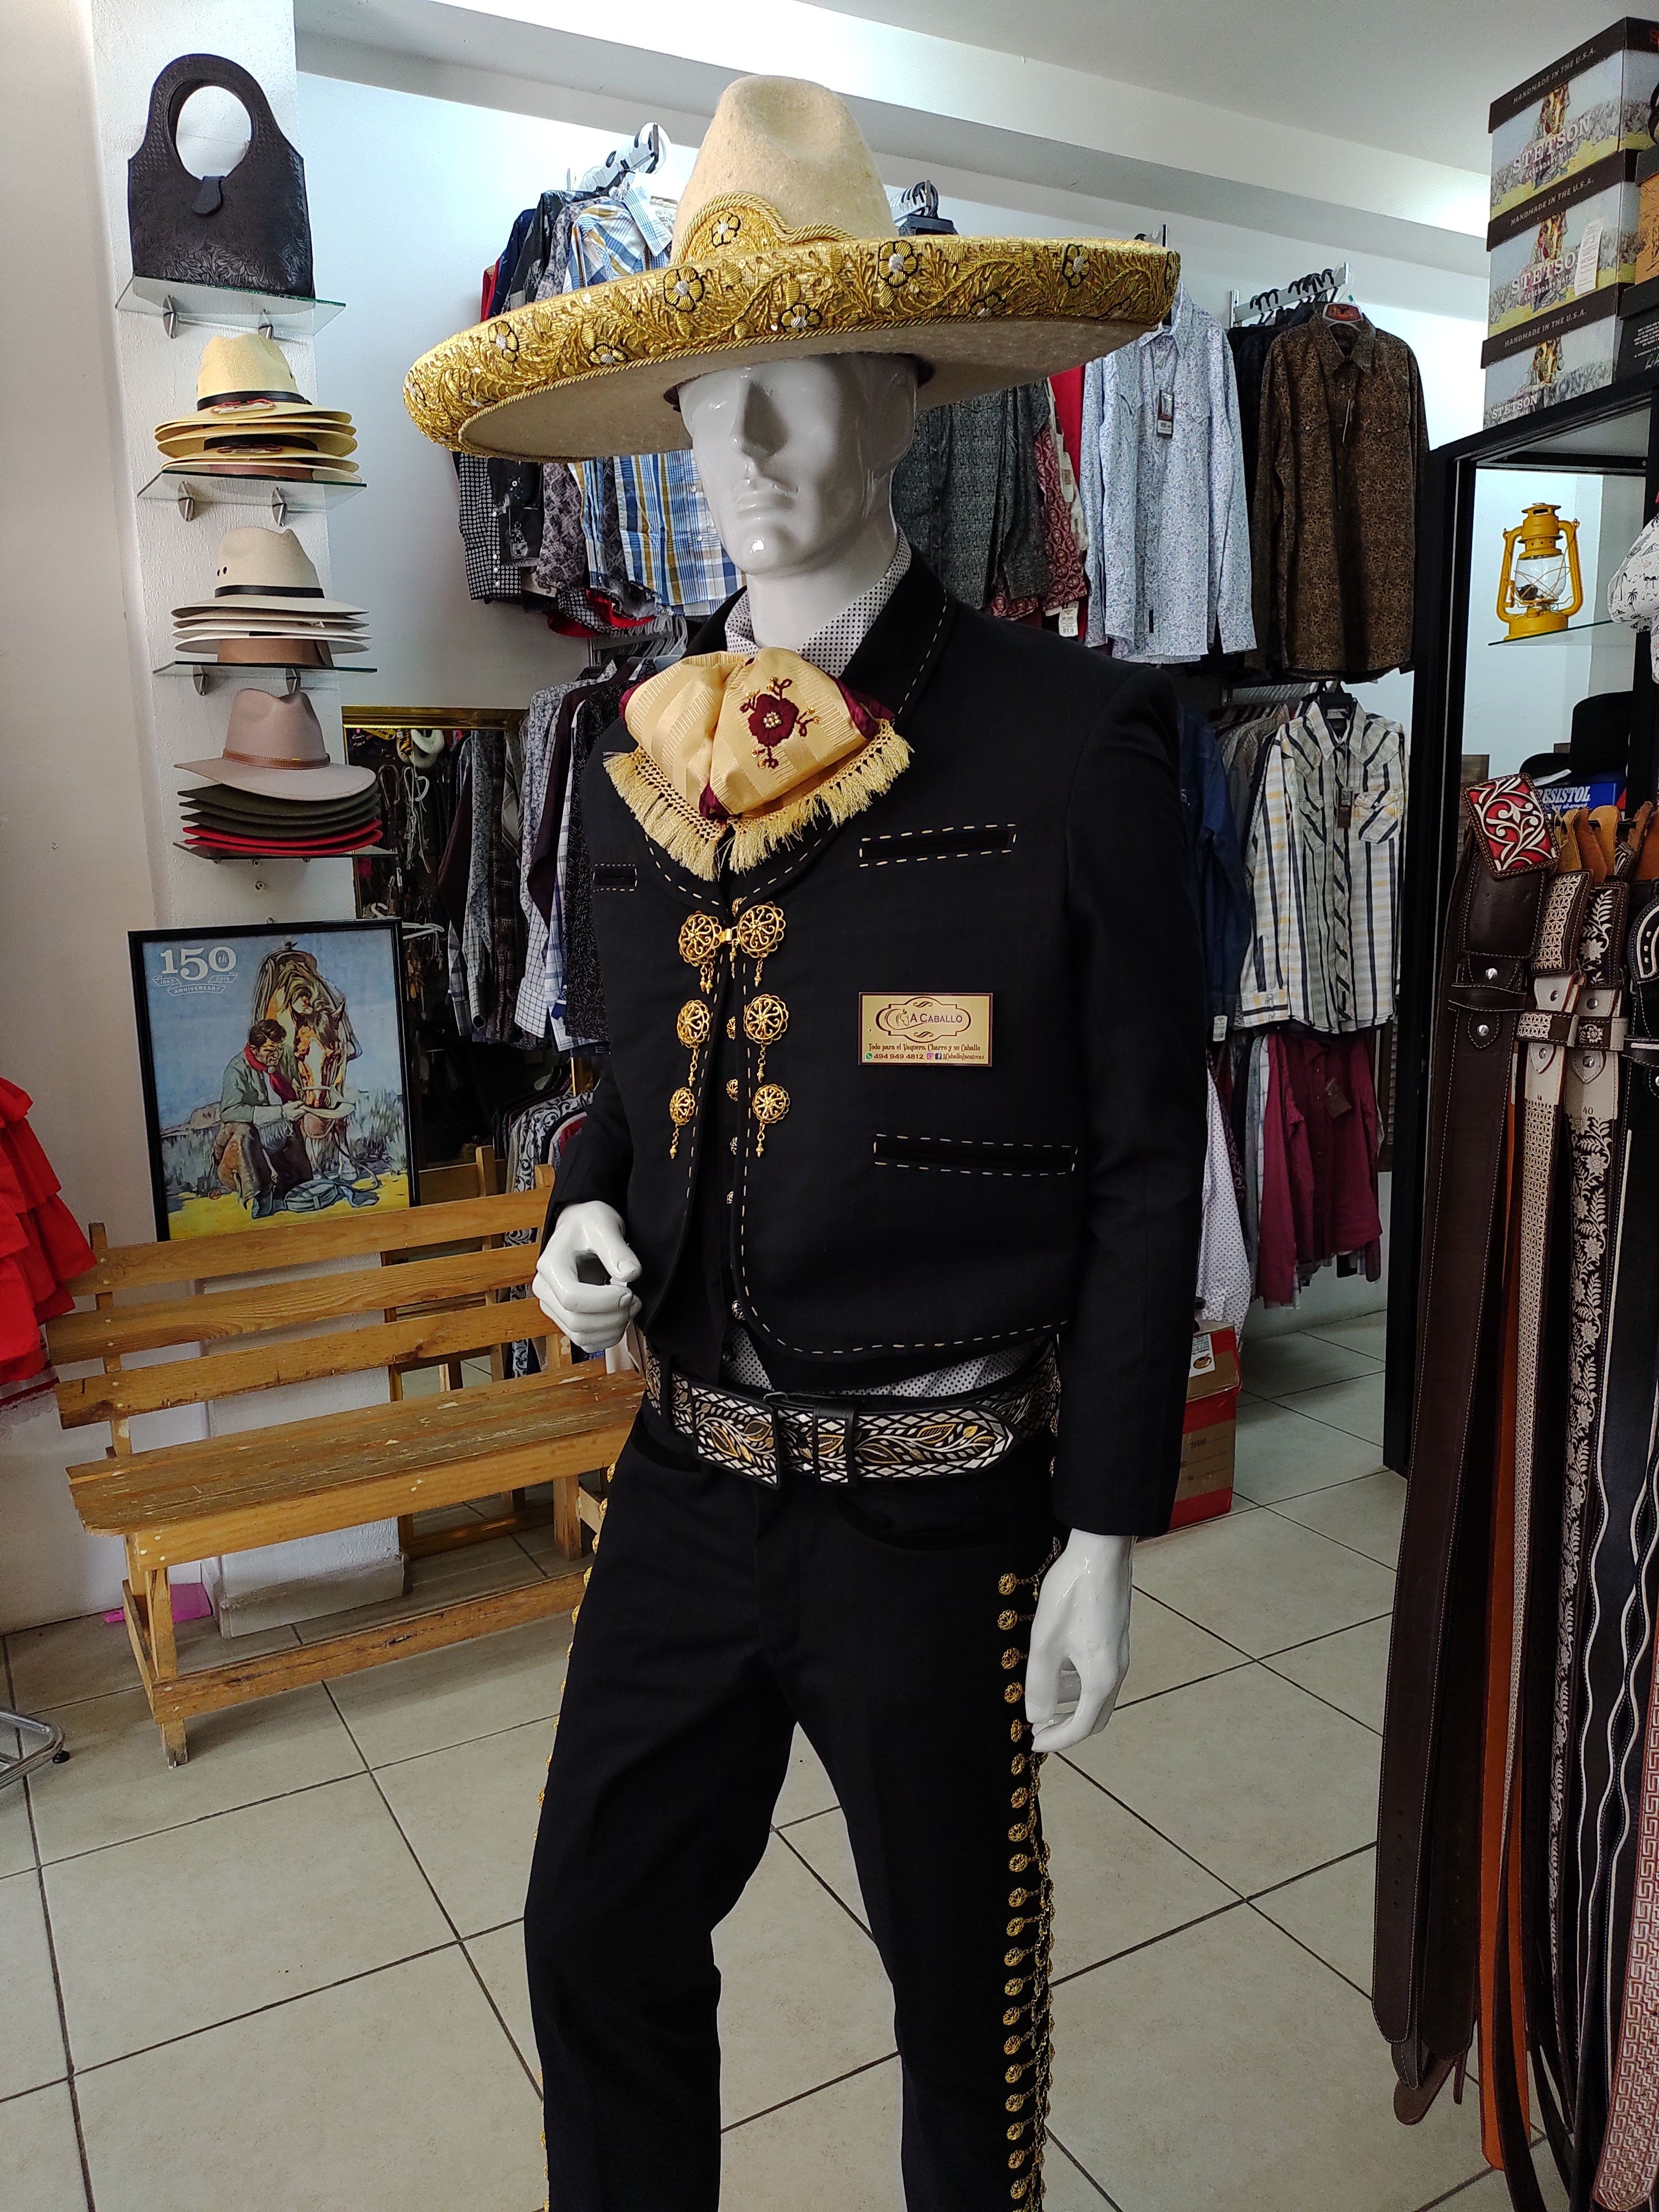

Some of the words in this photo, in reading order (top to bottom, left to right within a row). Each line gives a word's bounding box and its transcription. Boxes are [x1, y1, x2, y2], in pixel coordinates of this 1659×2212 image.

[1513, 75, 1550, 105] HANDMADE
[1551, 69, 1561, 80] IN
[1561, 60, 1575, 74] THE
[1575, 47, 1597, 64] U.S.A.
[1513, 117, 1593, 175] STETSON
[1510, 200, 1547, 226] HANDMADE
[1548, 195, 1556, 206] IN
[1557, 187, 1572, 201] THE
[1573, 178, 1594, 192] U.S.A.
[1511, 251, 1577, 295] STETSO
[1525, 281, 1557, 300] LEGENDARY
[1504, 327, 1541, 348] HANDMADE
[1542, 323, 1550, 332] IN
[1551, 316, 1566, 328] THE
[1566, 308, 1587, 322] U.S.A.
[1491, 393, 1538, 419] STETSON
[160, 946, 237, 981] 150
[218, 954, 227, 963] th
[174, 985, 221, 995] ANNIVERSARY
[910, 1014, 917, 1022] A
[920, 1013, 963, 1023] CABALLO
[868, 1043, 881, 1051] Todo
[903, 1043, 926, 1052] Vaquero,
[927, 1044, 947, 1052] Charro
[961, 1044, 980, 1052] Caballo
[1582, 1106, 1594, 1115] 40
